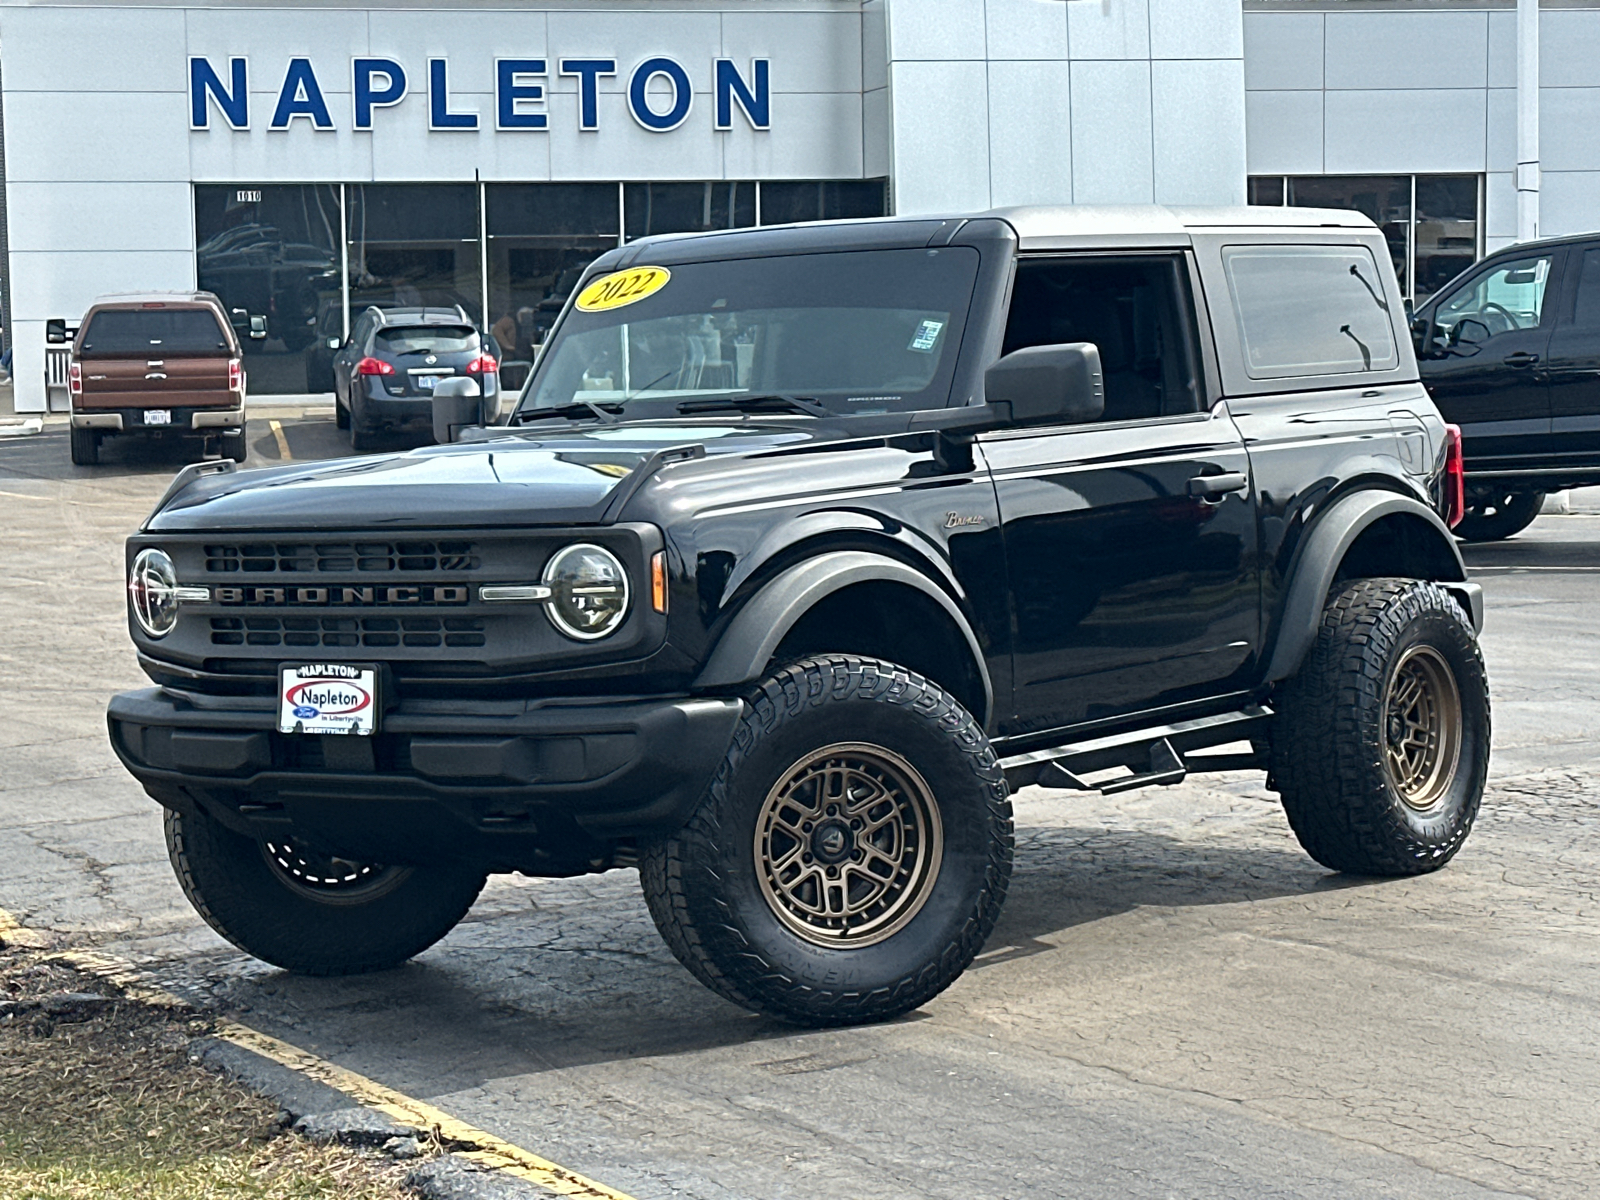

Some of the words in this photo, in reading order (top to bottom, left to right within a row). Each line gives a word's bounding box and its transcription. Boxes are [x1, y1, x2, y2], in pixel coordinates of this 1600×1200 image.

[189, 56, 771, 132] NAPLETON
[237, 190, 261, 202] 1010
[587, 271, 657, 306] 2022
[214, 586, 468, 603] BRONCO
[301, 664, 356, 678] NAPLETON
[301, 687, 358, 709] Napleton
